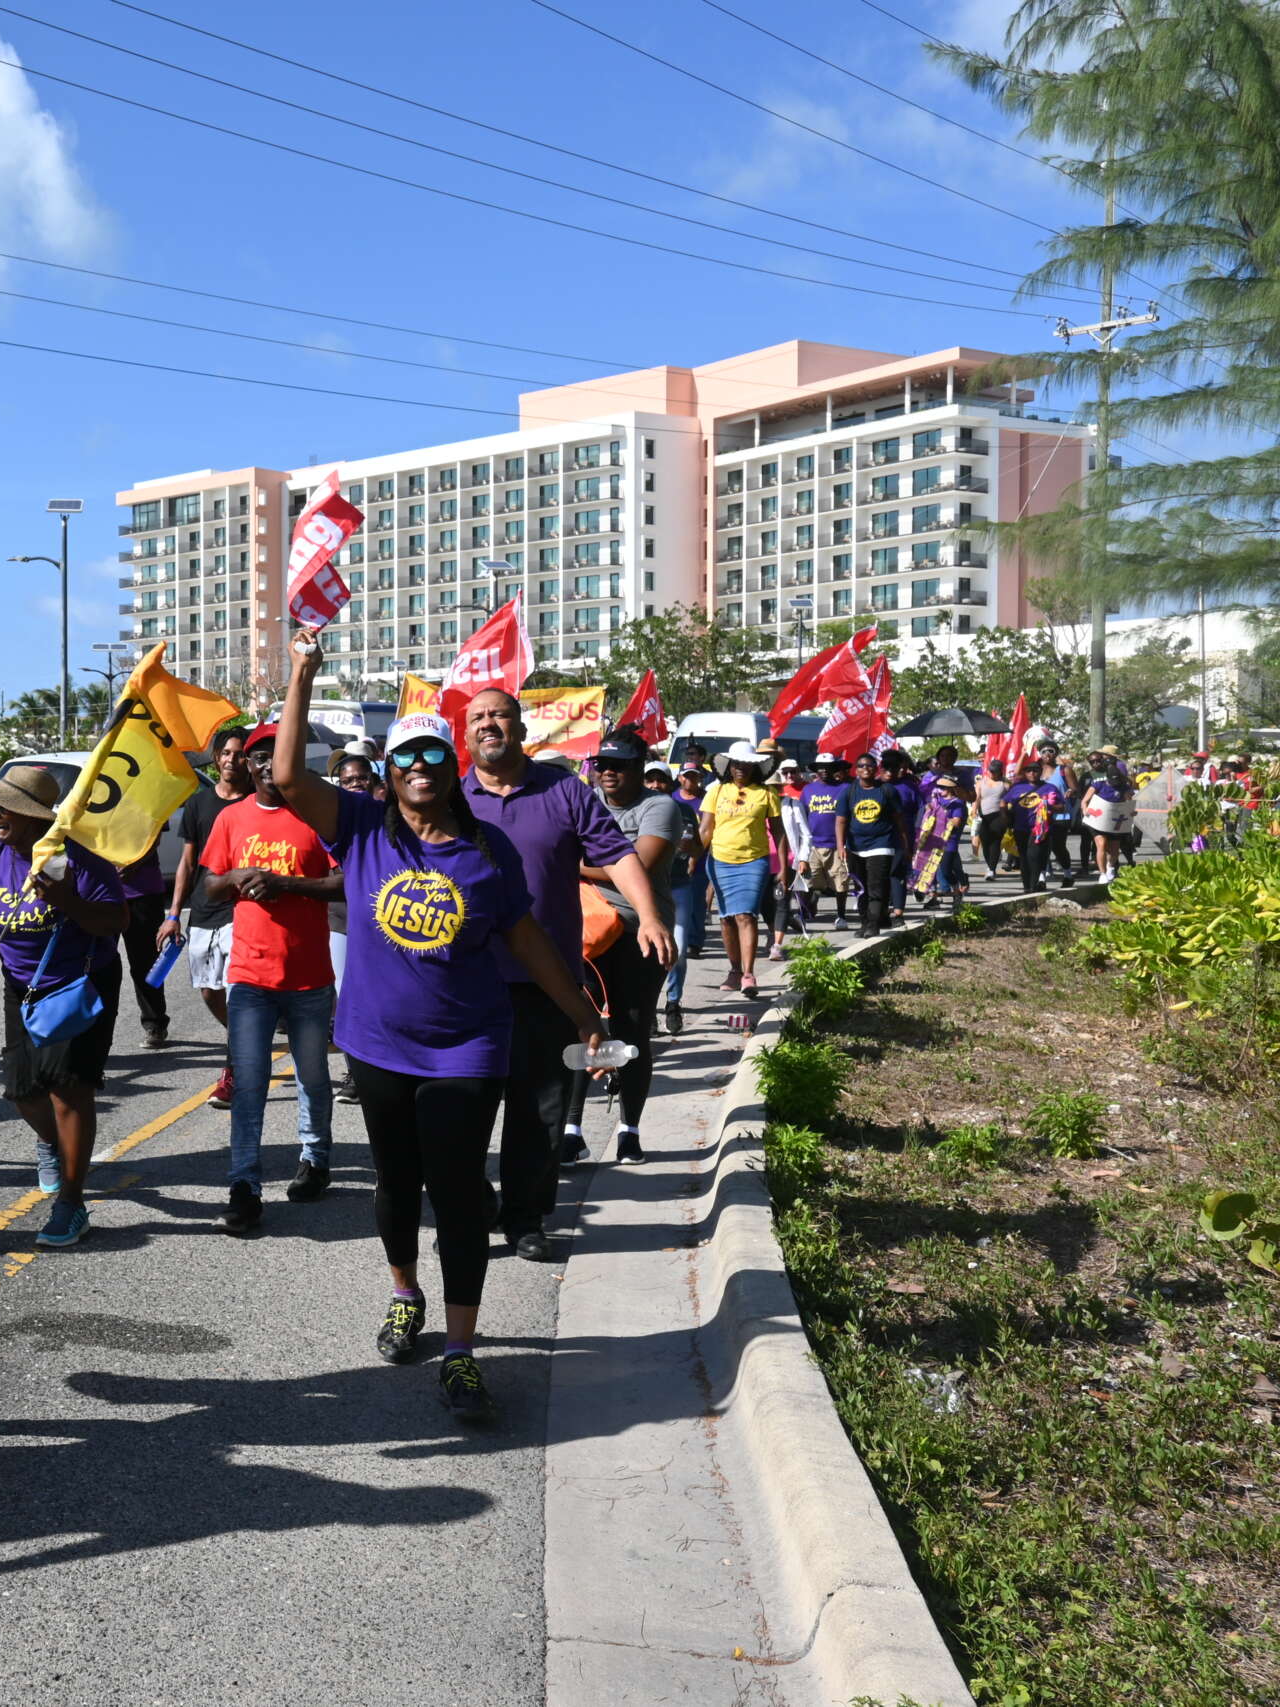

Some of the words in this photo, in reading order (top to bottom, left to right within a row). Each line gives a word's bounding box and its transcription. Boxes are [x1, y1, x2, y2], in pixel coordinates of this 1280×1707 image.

[530, 701, 599, 721] JESUS
[242, 833, 293, 859] Jesus
[401, 877, 449, 893] Thank
[423, 890, 454, 905] You
[378, 893, 461, 944] JESUS
